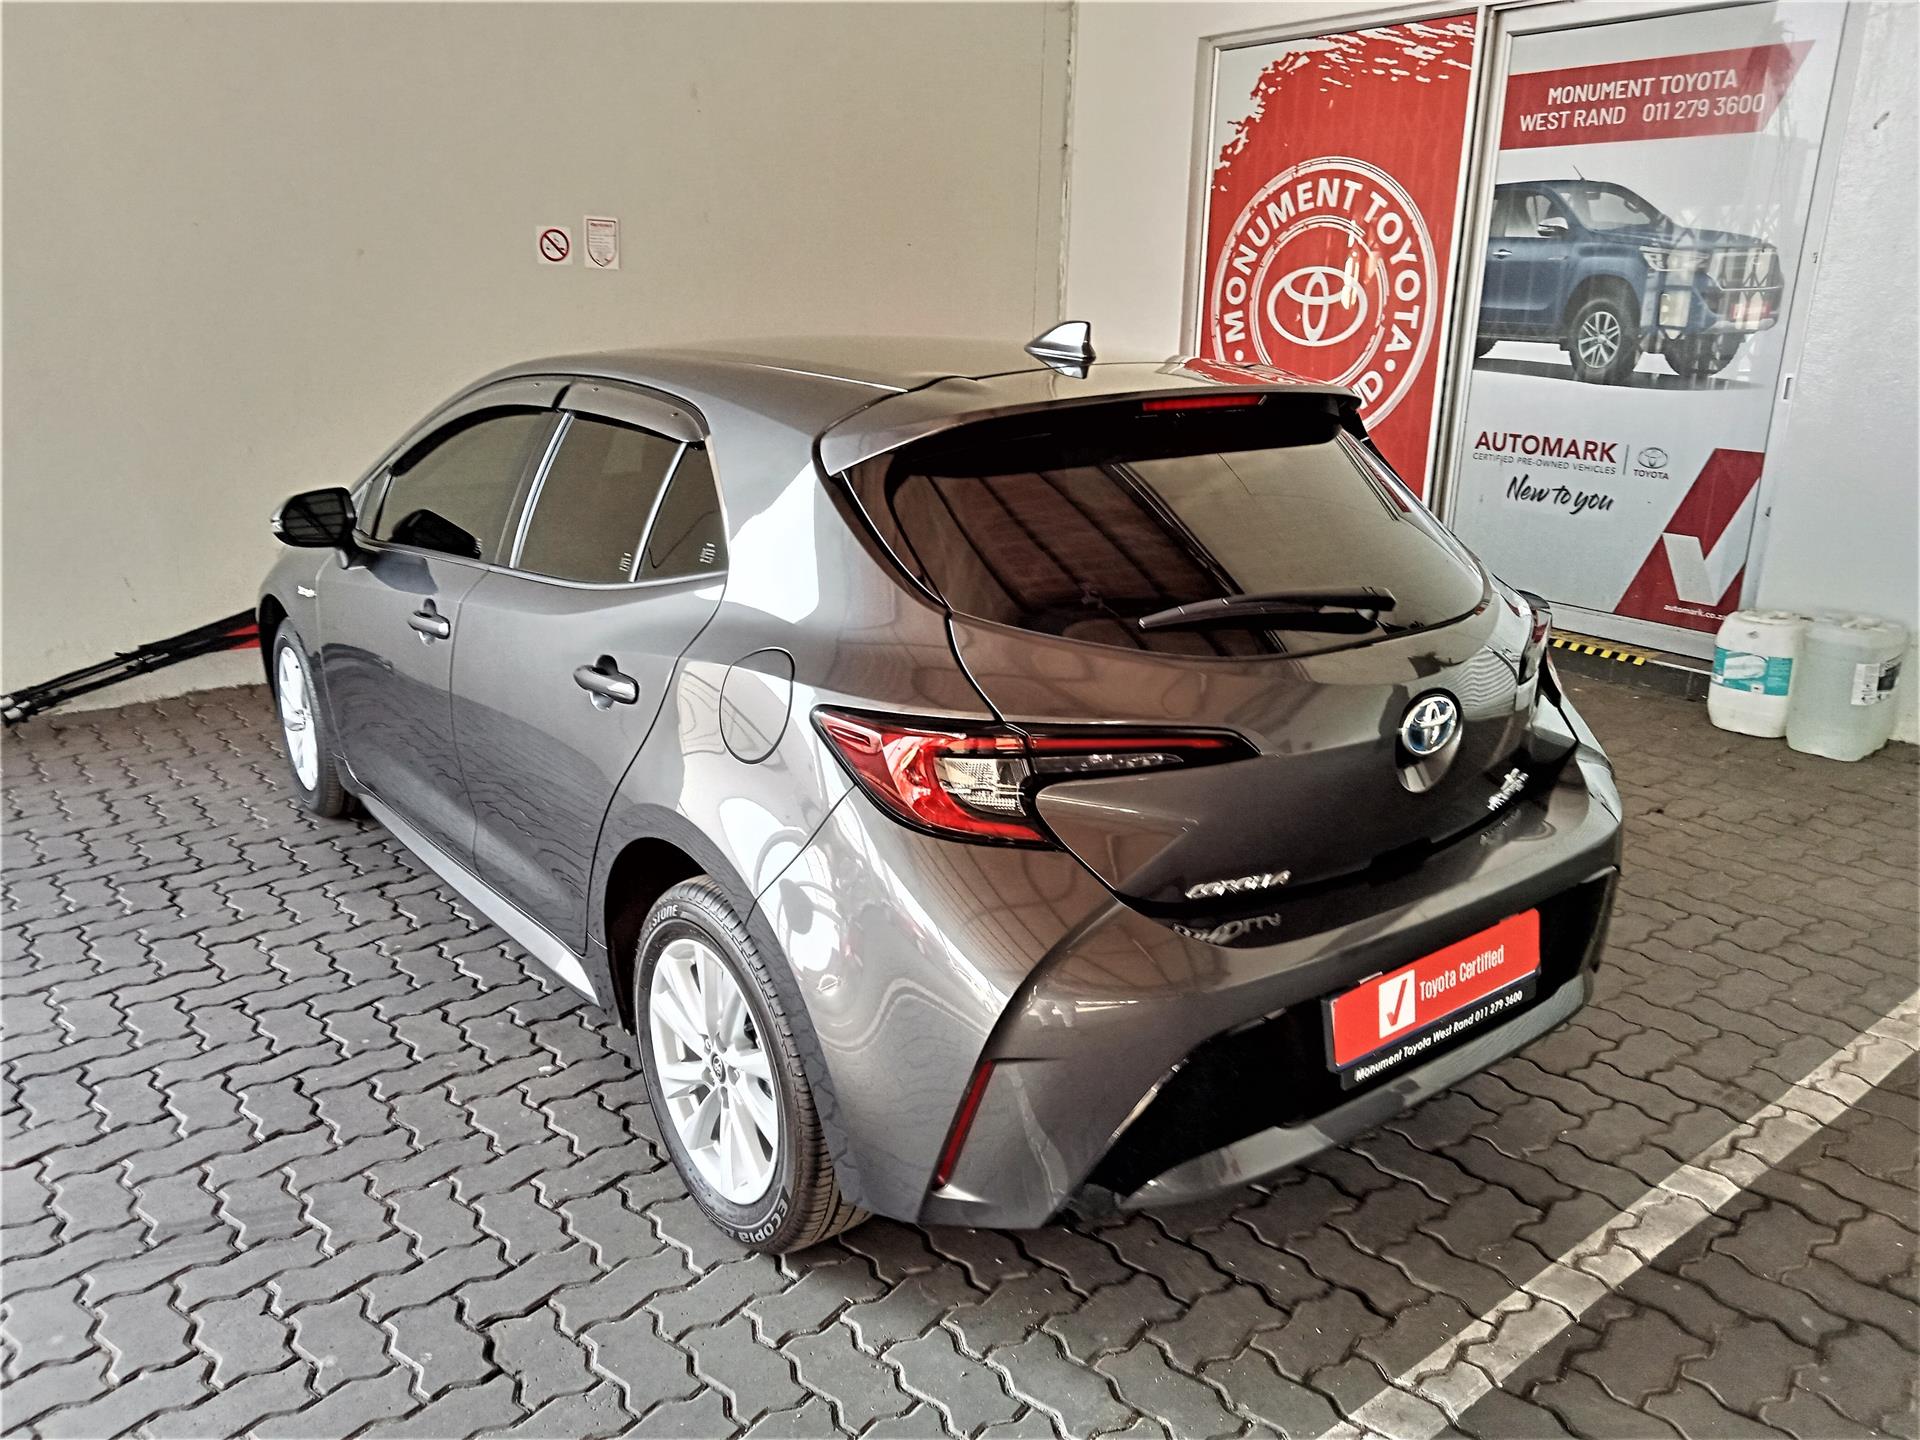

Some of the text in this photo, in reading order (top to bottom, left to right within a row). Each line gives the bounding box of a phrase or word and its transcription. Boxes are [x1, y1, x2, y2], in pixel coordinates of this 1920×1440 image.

[1547, 69, 1739, 105] MONUMENT TOYOTA
[1520, 93, 1765, 132] WEST RAND 011 279 3600
[1223, 177, 1421, 353] MONUMENT TOYOTA
[1472, 452, 1616, 475] CERTIFIED PRE-OWNED VEHICLES
[1474, 431, 1618, 463] AUTOMARK
[1633, 469, 1669, 480] TOYOTA
[1507, 474, 1614, 515] New to you
[1419, 944, 1504, 1001] Toyota Certified
[1354, 990, 1523, 1082] Monument Toyota West Rand 011 279 3600
